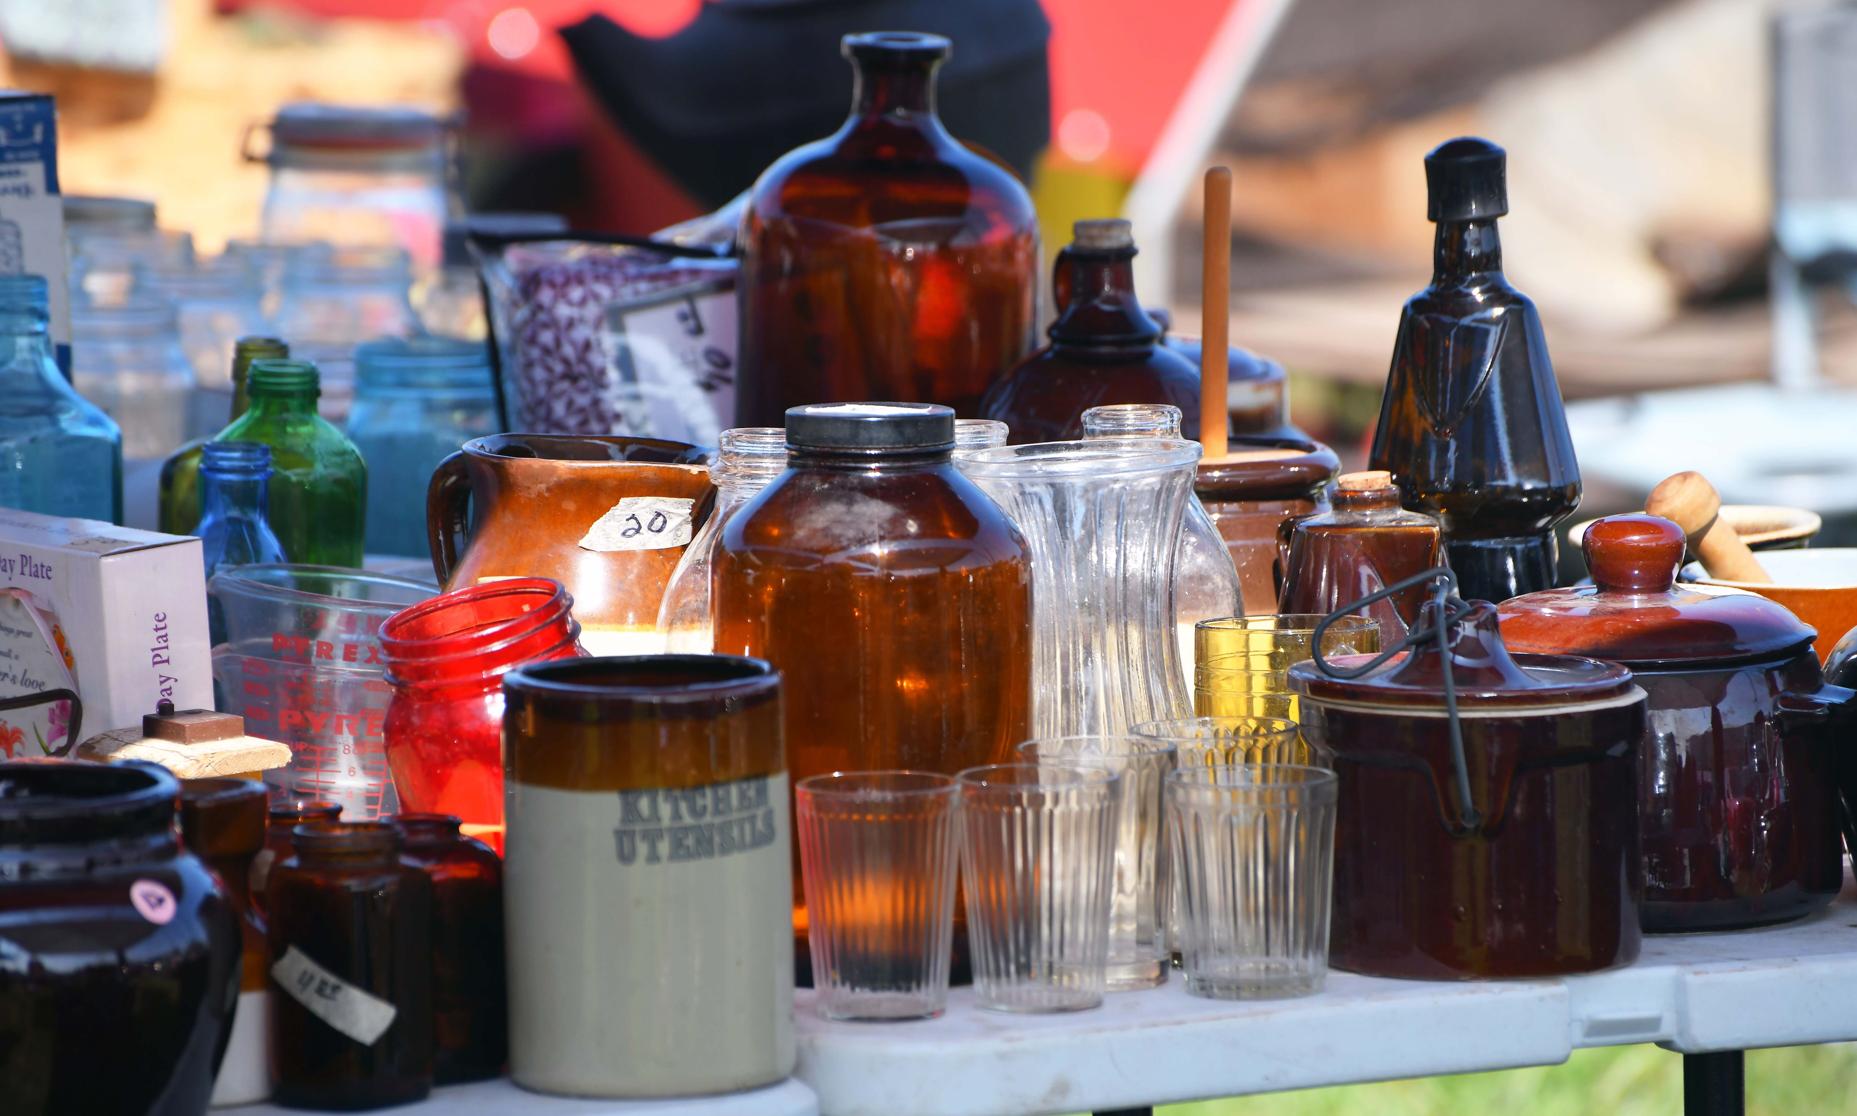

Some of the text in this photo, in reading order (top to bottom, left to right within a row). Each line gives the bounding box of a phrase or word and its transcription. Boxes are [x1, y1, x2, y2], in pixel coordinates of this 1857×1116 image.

[621, 511, 668, 538] 20
[0, 554, 53, 580] ay Plate
[151, 612, 170, 668] Plate
[278, 709, 386, 737] PYRE
[613, 806, 775, 867] UTENSILS
